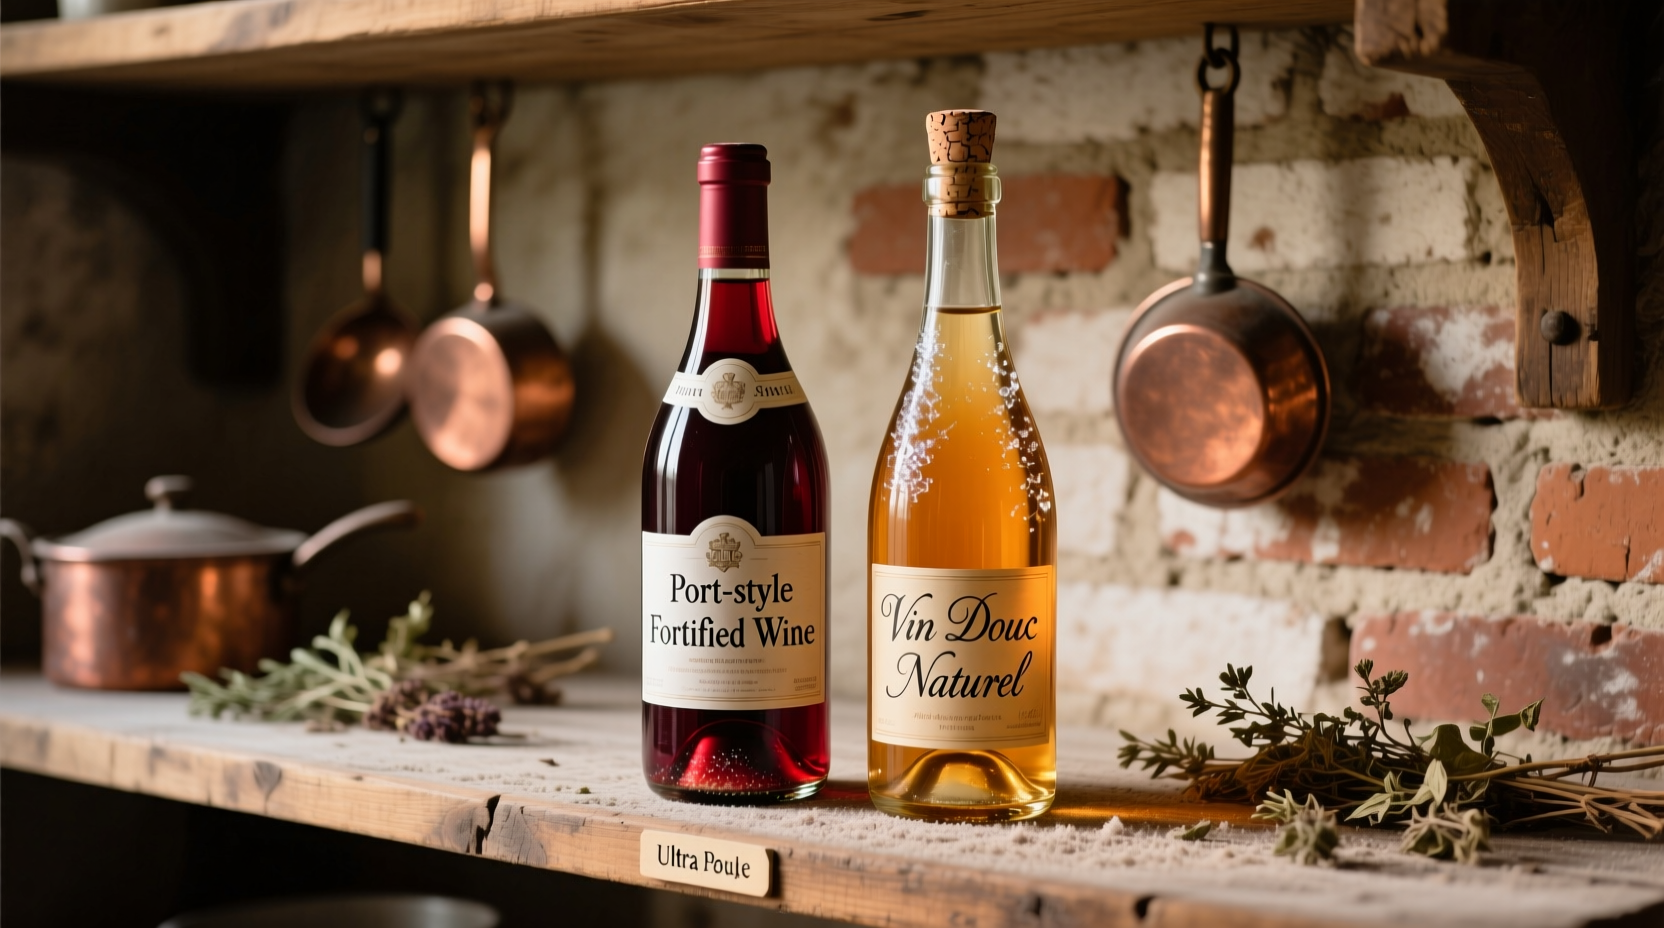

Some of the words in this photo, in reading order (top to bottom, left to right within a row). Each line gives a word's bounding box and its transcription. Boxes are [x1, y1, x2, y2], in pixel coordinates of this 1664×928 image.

[670, 573, 793, 612] Port-style
[650, 614, 745, 648] Fortified
[752, 616, 815, 648] Wine
[881, 593, 937, 642] Vin
[945, 592, 1038, 642] Douc
[886, 650, 1033, 698] Naturel
[657, 844, 698, 871] Ultra
